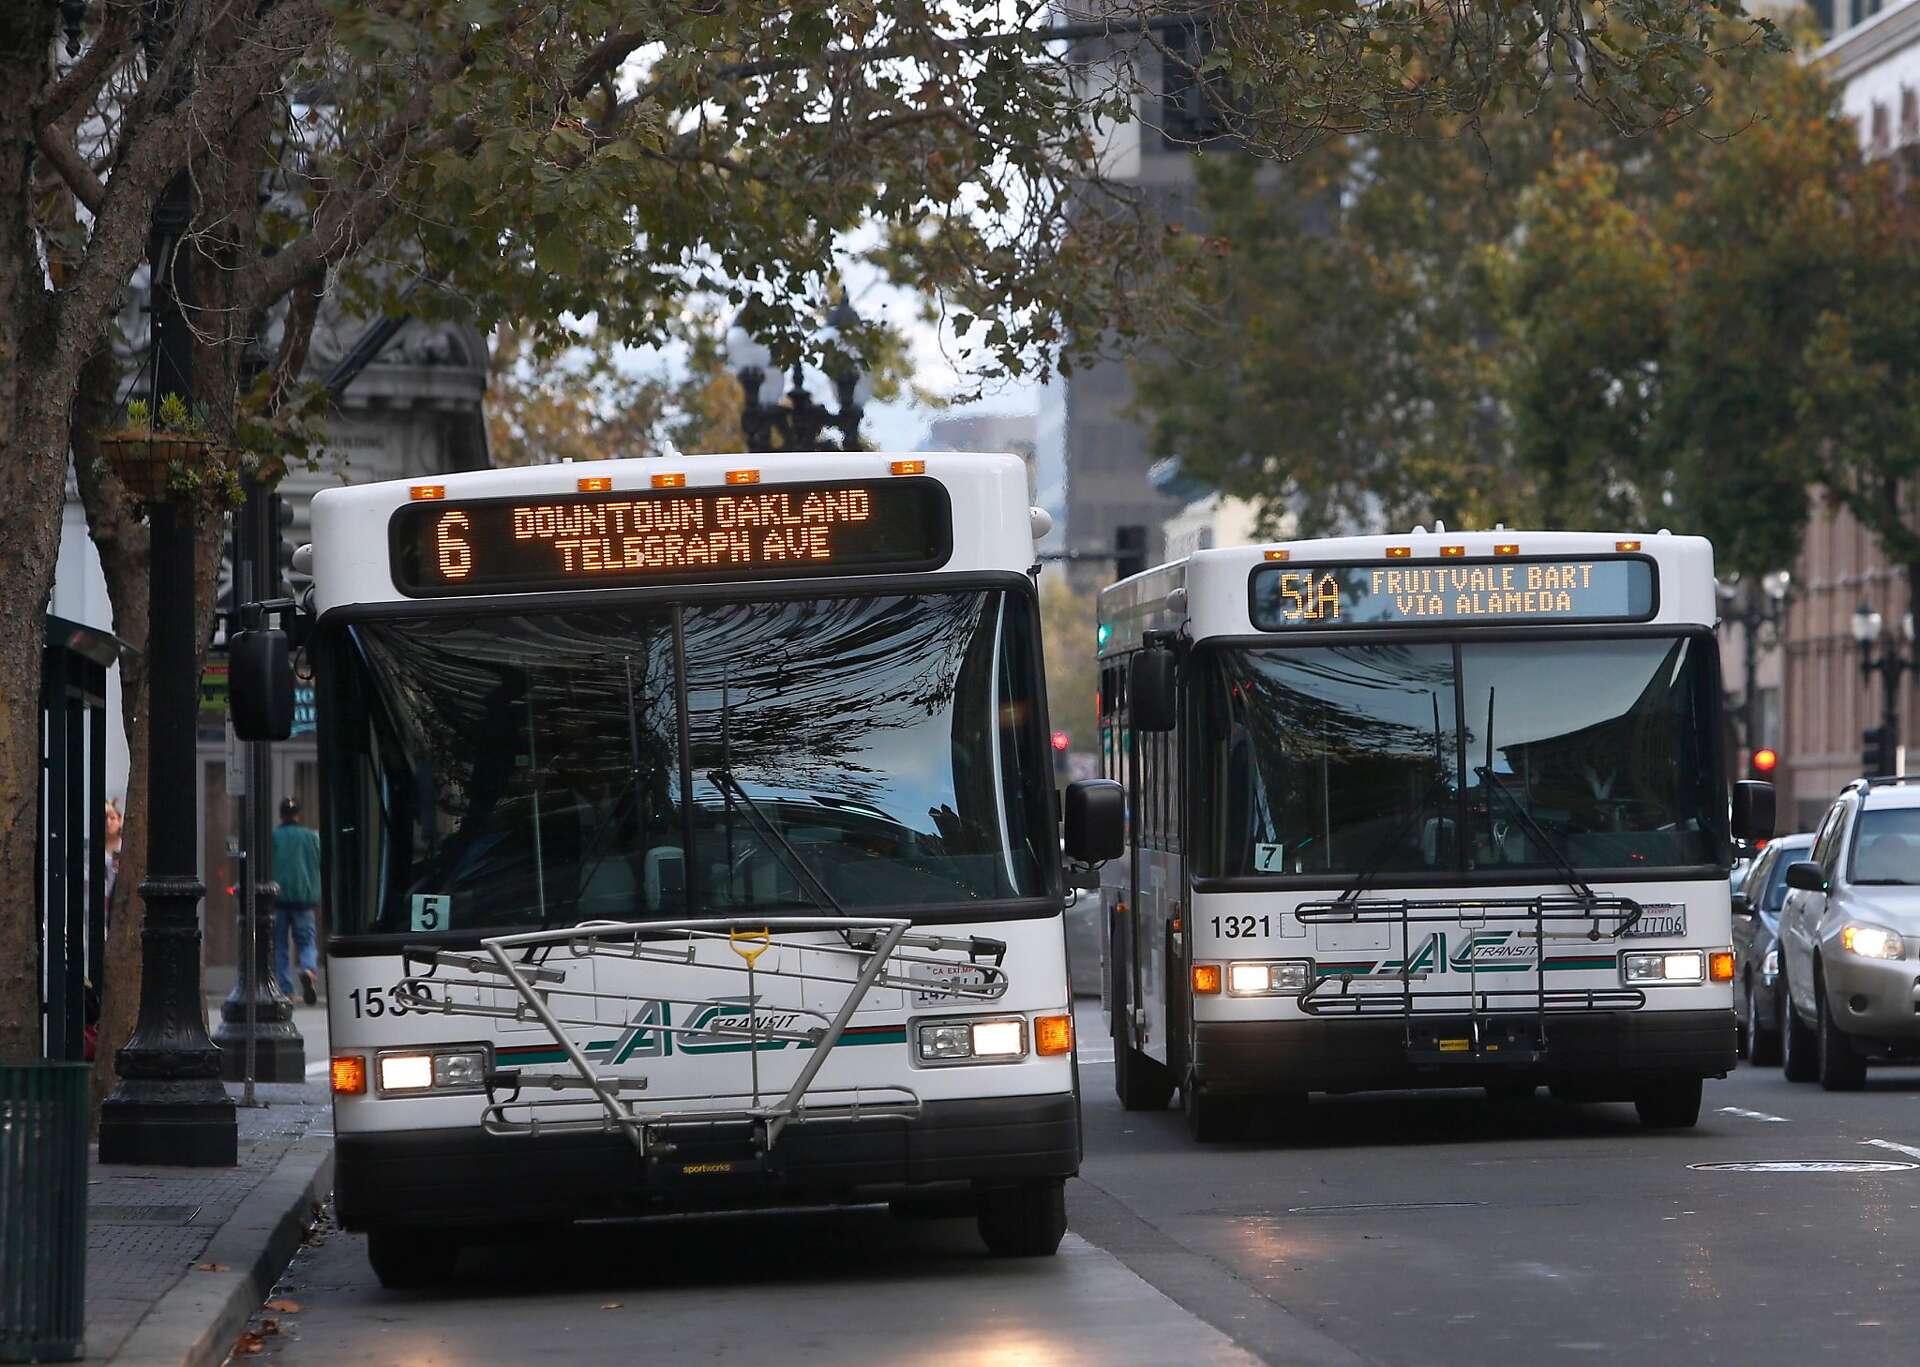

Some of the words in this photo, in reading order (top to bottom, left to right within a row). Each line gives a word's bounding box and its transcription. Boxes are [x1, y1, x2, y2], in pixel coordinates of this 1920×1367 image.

[514, 498, 703, 539] DOWNTOWN
[715, 489, 870, 528] OAKLAND
[436, 510, 472, 579] 6
[554, 530, 751, 572] TELEGRAPH
[763, 526, 831, 561] AVE
[1371, 567, 1515, 595] FRUITVALE
[1527, 564, 1593, 591] BART
[1280, 572, 1341, 620] 51A
[1397, 594, 1444, 616] VIA
[1456, 590, 1572, 615] ALAMEDA
[1262, 846, 1276, 868] 7
[421, 897, 438, 930] 5
[1211, 914, 1270, 939] 1321
[1474, 945, 1539, 957] TRANSIT
